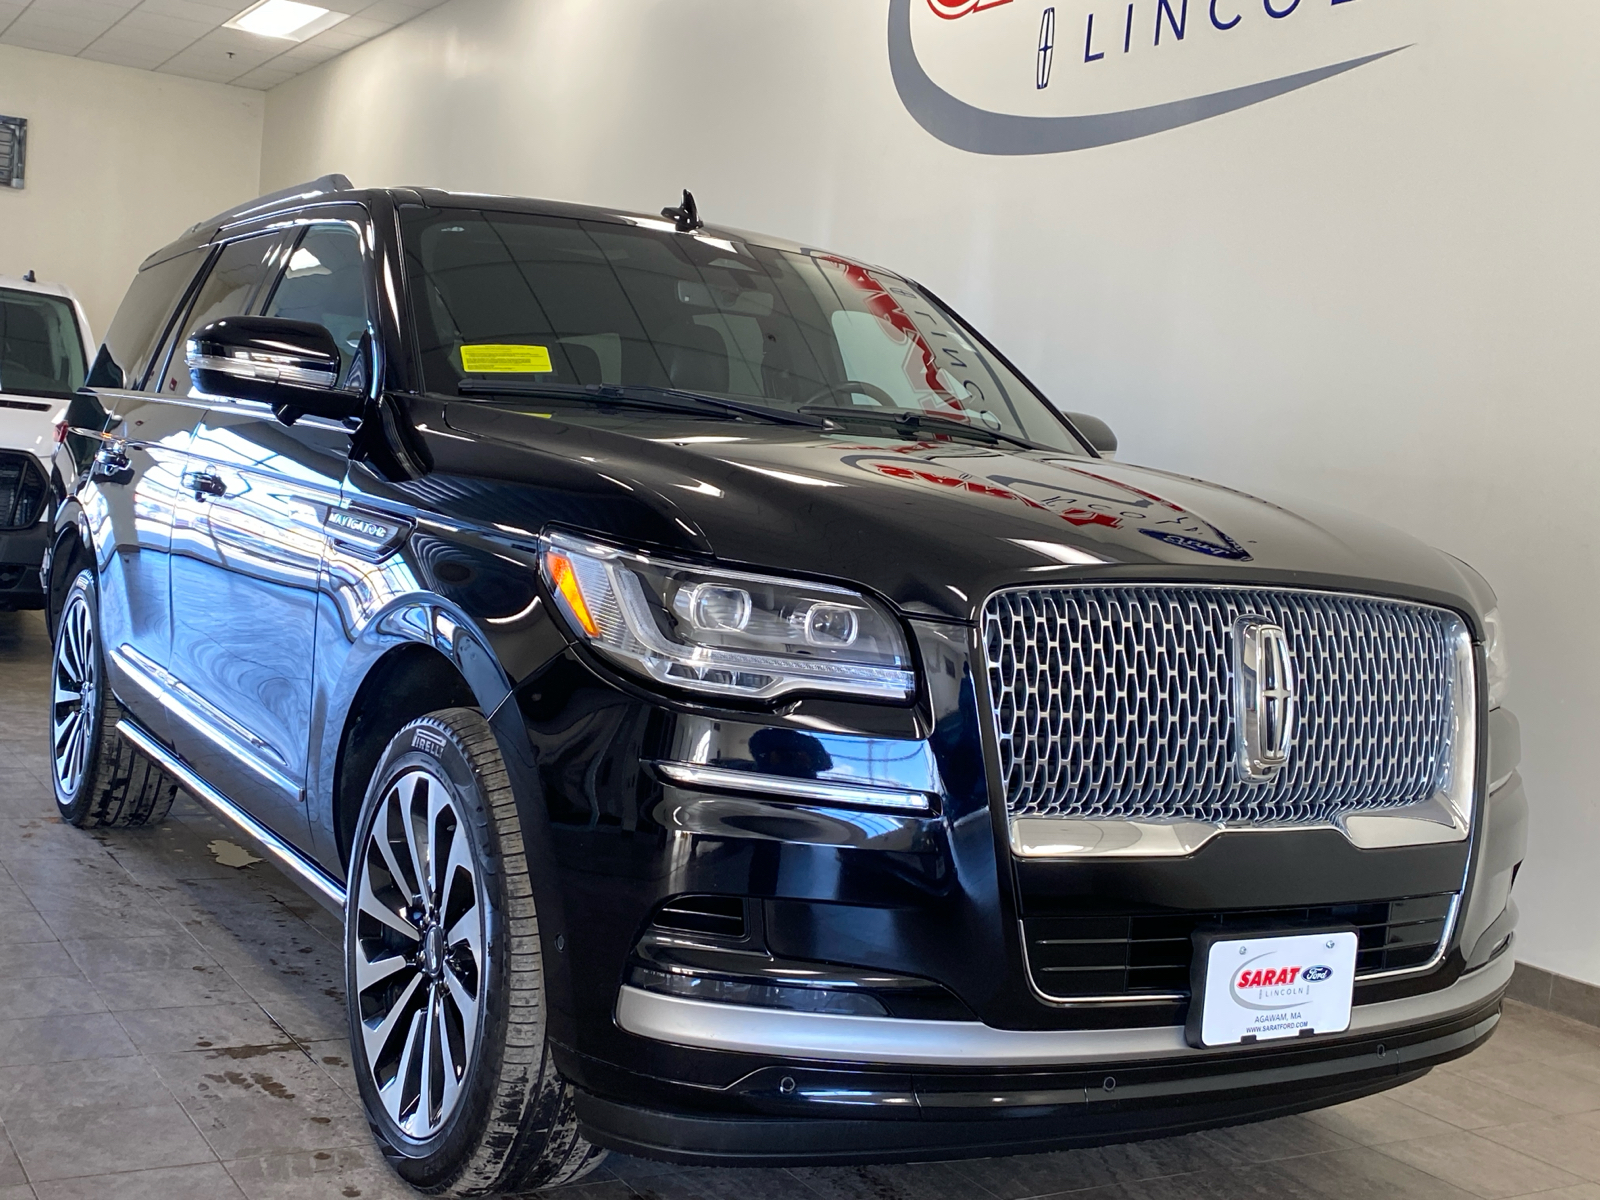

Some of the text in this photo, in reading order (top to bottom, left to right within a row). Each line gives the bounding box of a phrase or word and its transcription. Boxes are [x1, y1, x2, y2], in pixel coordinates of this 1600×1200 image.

[328, 513, 387, 537] NAVIGATOR
[411, 728, 447, 759] PIRELLI
[1237, 966, 1328, 989] SARAT Ford
[1265, 988, 1304, 998] LINCOLN
[1254, 1011, 1302, 1023] AGAWAM, MA
[1246, 1022, 1308, 1033] WWW.SARATFORD.COM
